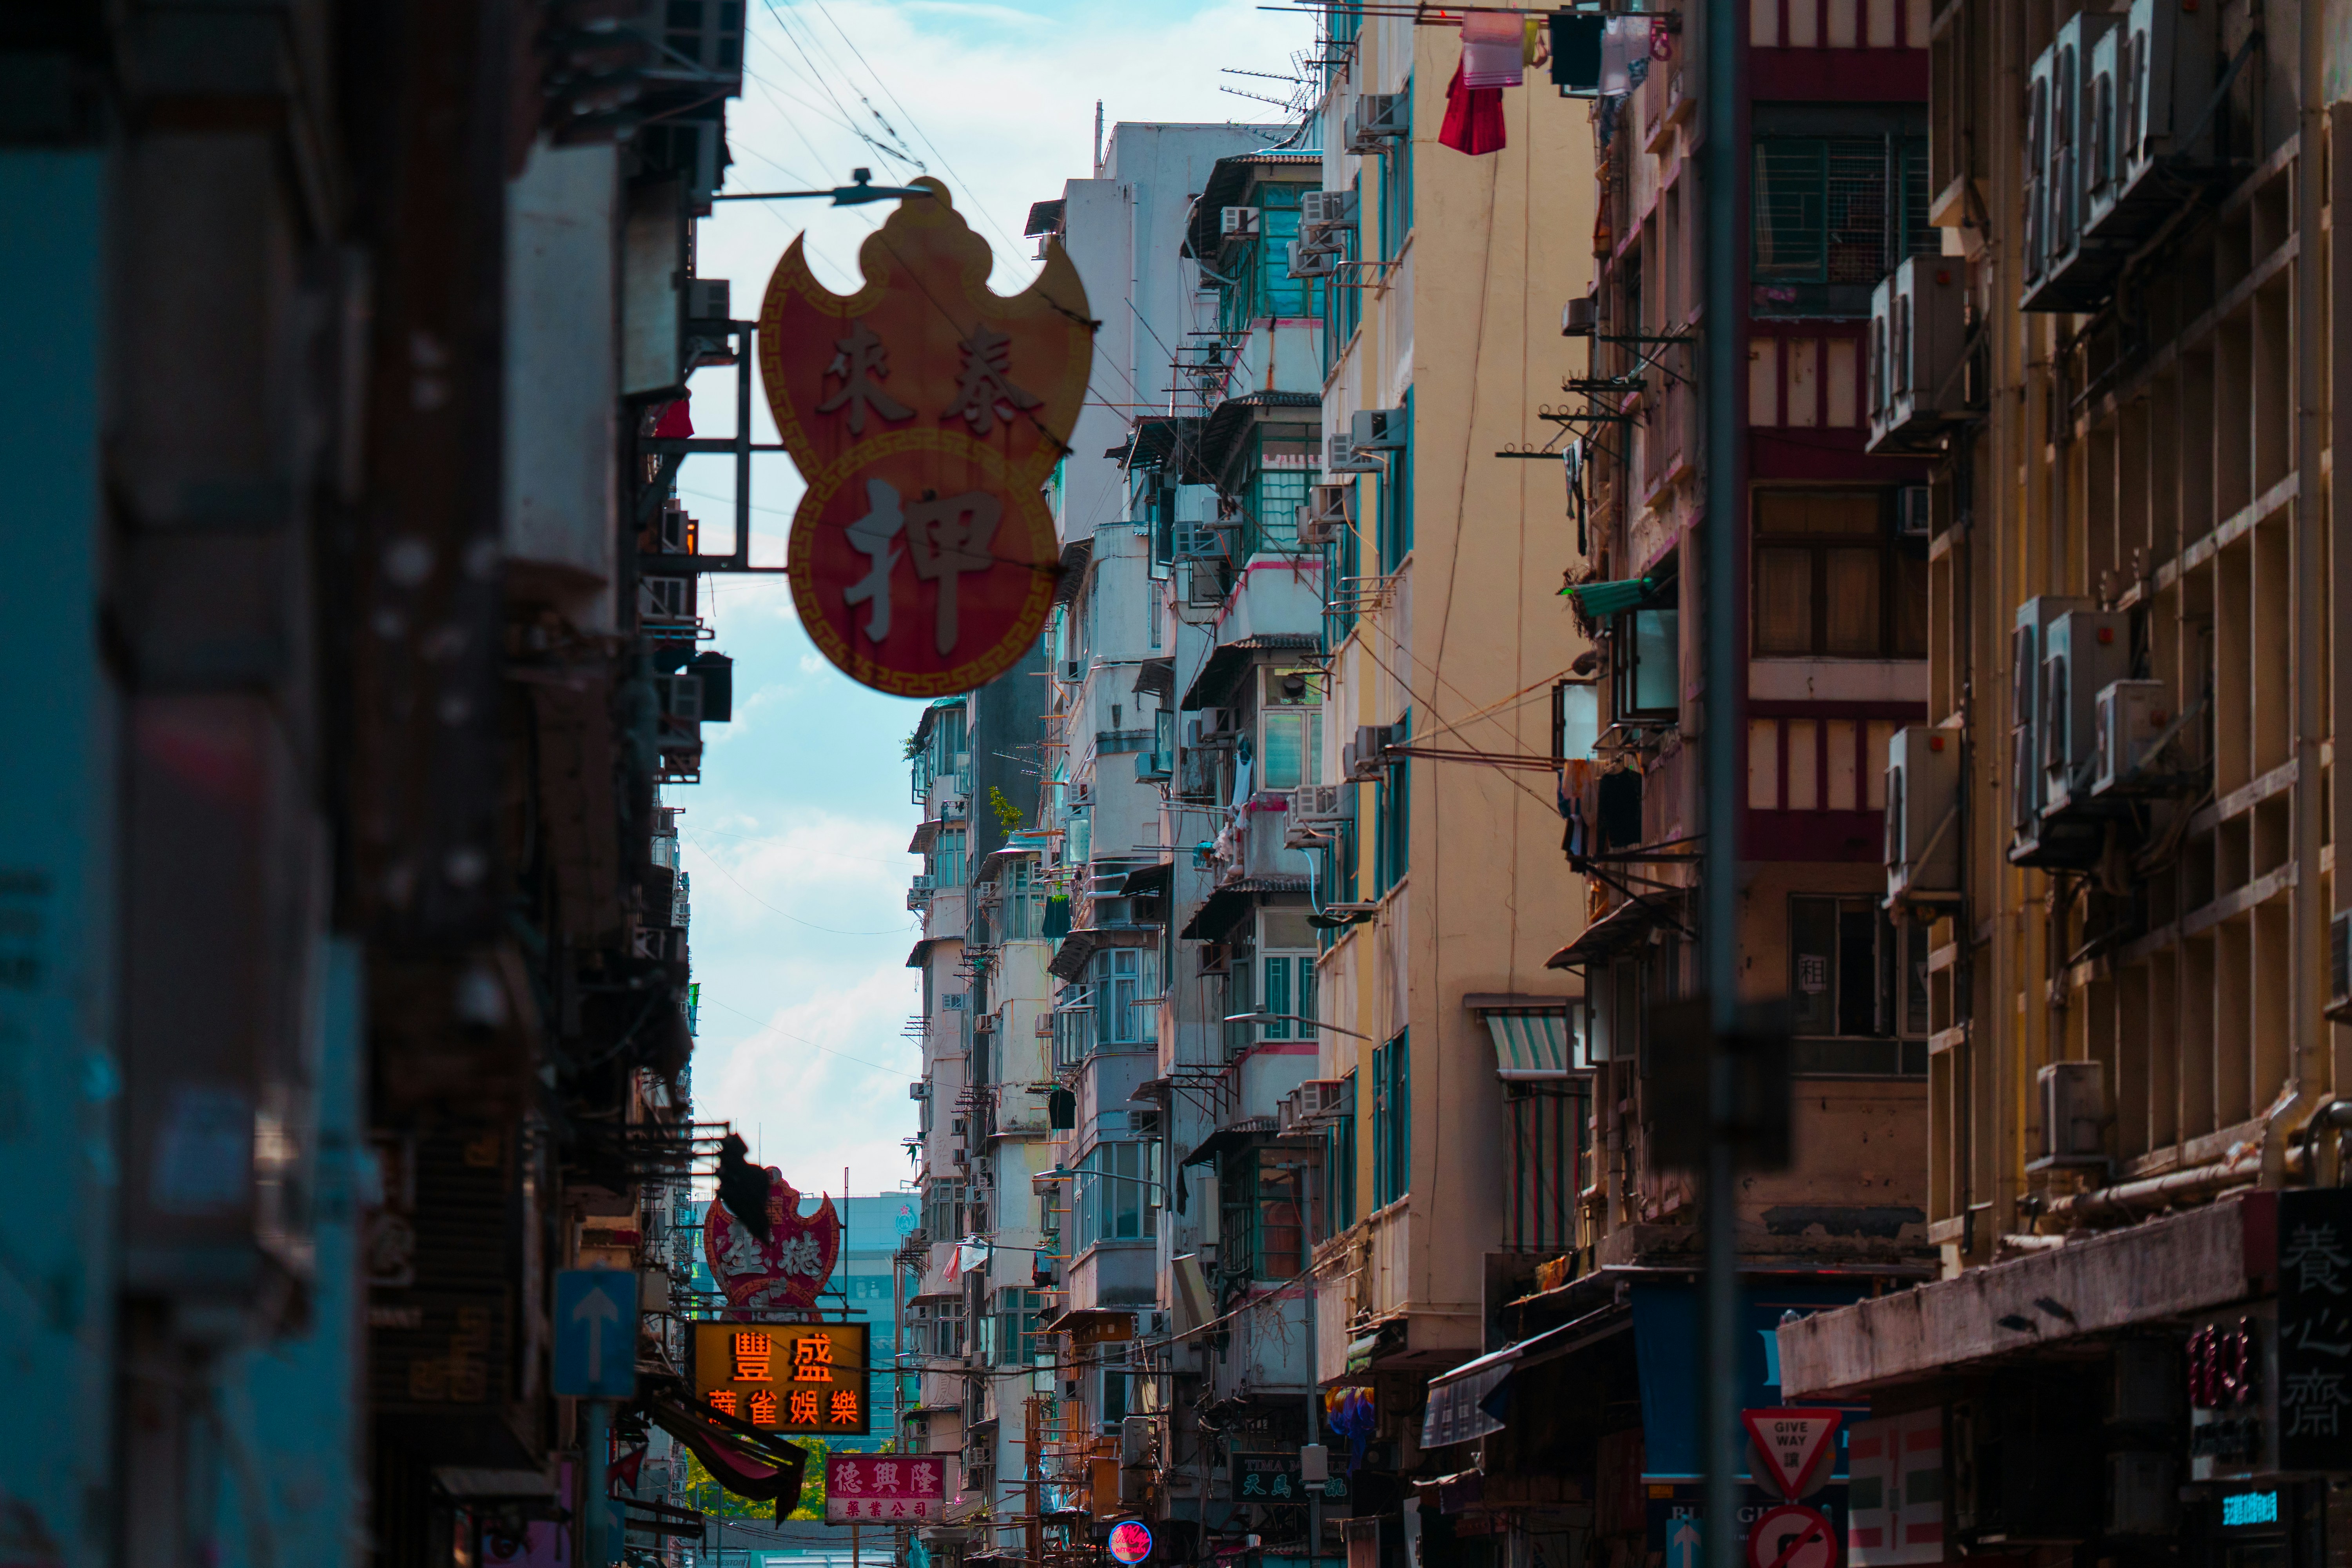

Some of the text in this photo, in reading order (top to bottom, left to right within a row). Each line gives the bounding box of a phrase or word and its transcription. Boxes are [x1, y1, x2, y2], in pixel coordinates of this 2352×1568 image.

[843, 476, 1004, 657] 押
[1800, 959, 1825, 985] 租
[2281, 1221, 2352, 1438] 養心齋
[733, 1332, 833, 1382] 豐盛
[1774, 1422, 1808, 1433] GIVE
[1777, 1436, 1806, 1446] WAY
[1245, 1459, 1284, 1472] TIMA
[1784, 1452, 1800, 1468] 讓
[835, 1461, 938, 1494] 德興隆
[1242, 1473, 1347, 1498] 天馬訊
[845, 1501, 926, 1517] 藥業公司
